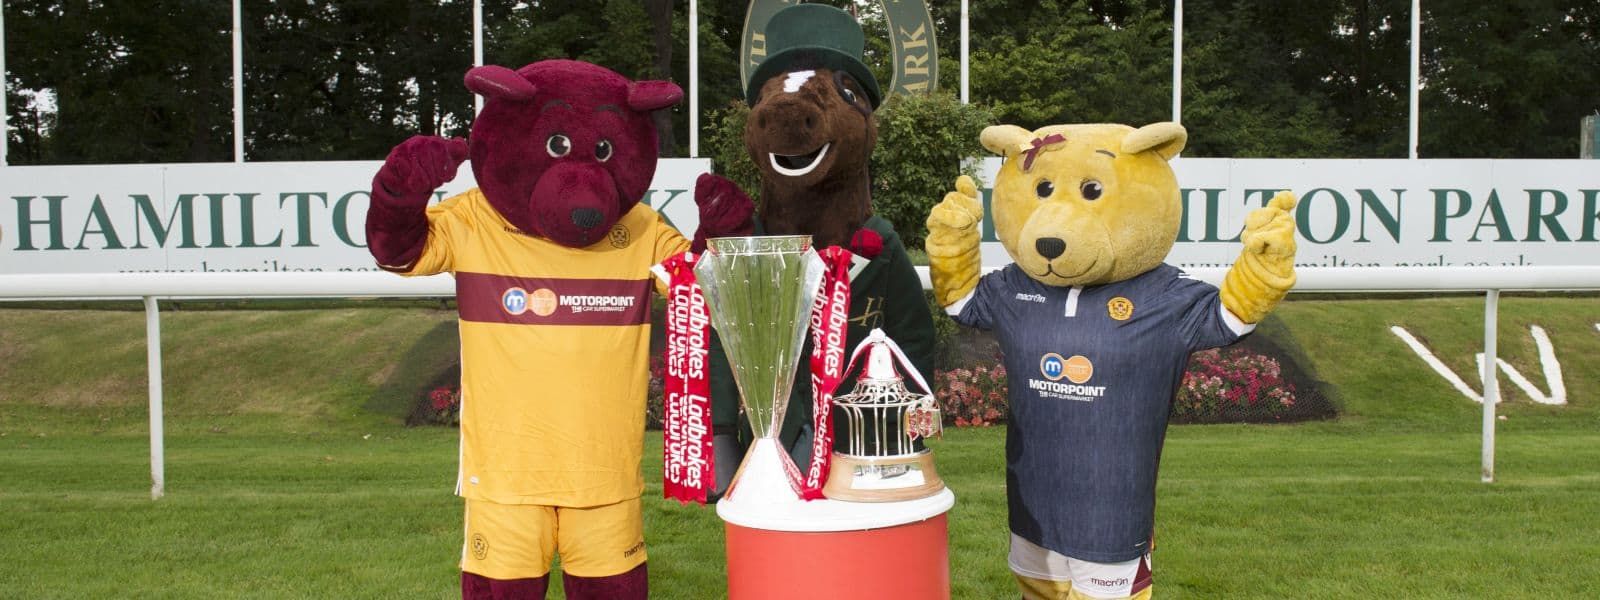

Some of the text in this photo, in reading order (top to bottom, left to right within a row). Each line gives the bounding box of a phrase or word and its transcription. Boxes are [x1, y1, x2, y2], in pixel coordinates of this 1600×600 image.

[899, 21, 930, 96] ARK
[11, 189, 449, 251] HAMILTO
[559, 295, 635, 307] MOTORPOINT
[688, 283, 710, 381] Ladbrokes
[824, 281, 848, 379] Ladbrokes
[1028, 378, 1107, 397] MOTORPOINT
[1058, 393, 1094, 402] SUPERMARKET
[687, 394, 708, 490] Ladbrokes
[806, 393, 833, 490] Ladbrokes
[1090, 577, 1128, 587] macron
